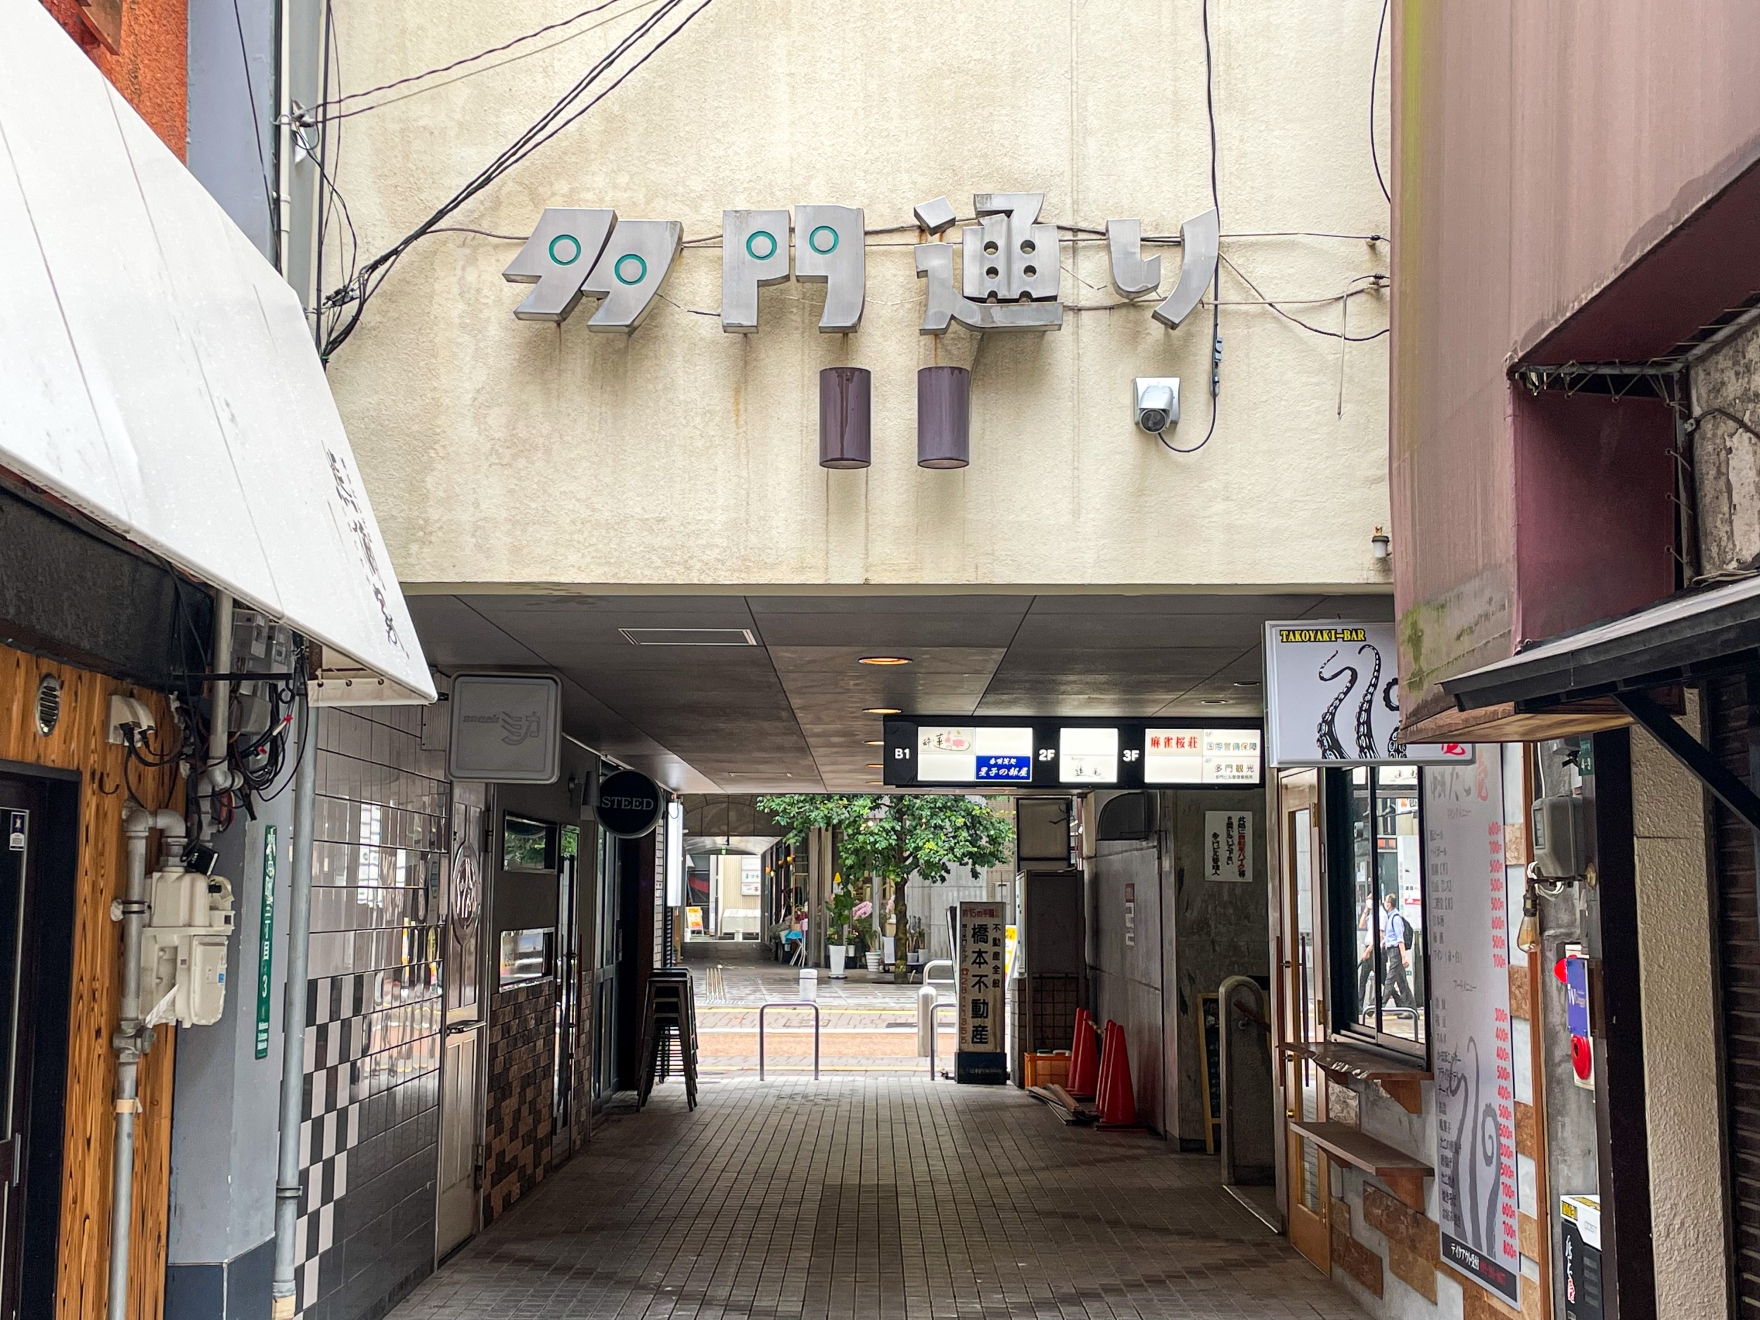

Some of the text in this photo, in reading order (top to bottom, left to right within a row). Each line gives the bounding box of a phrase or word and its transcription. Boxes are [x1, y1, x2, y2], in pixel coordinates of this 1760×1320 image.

[502, 192, 1219, 332] 多門通り
[1280, 629, 1366, 642] TAKOYAKI-BAR
[1150, 736, 1198, 749] 麻雀桜荘
[894, 748, 910, 759] B1
[1039, 749, 1055, 761] 2F
[1123, 749, 1140, 762] 3F
[1214, 764, 1255, 773] 多門観光
[601, 796, 654, 810] STEED
[970, 923, 989, 1045] 橋本不動産
